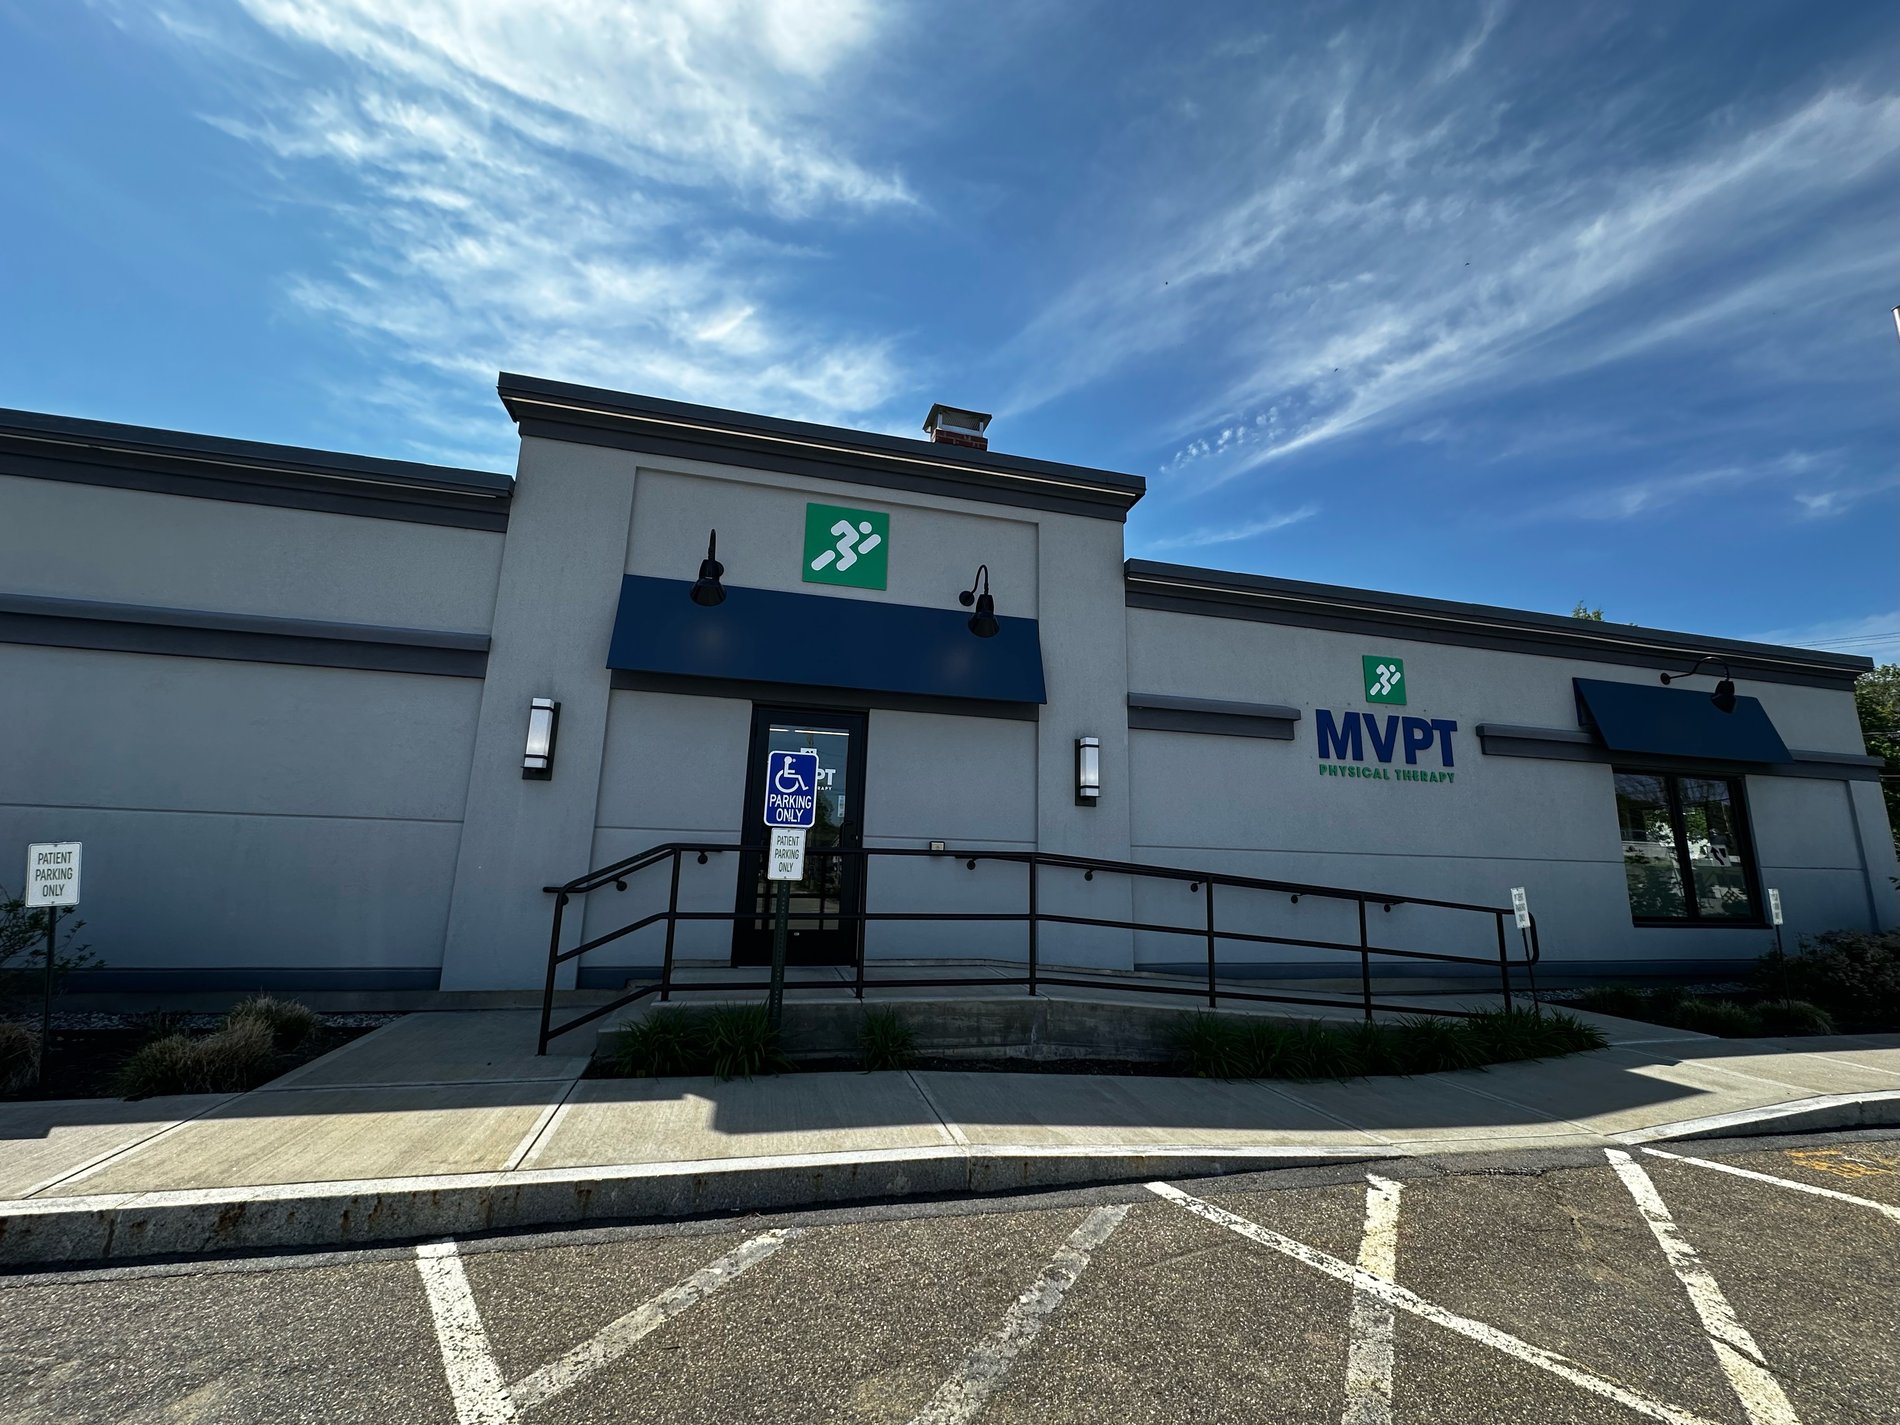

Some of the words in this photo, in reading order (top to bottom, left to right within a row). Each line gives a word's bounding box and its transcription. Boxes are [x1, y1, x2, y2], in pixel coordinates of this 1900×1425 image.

[1315, 708, 1458, 767] MVPT
[817, 768, 836, 786] PT
[1319, 763, 1390, 781] PHYSICAL
[1394, 768, 1456, 784] THERAPY
[769, 794, 812, 809] PARKING
[775, 809, 804, 823] ONLY
[776, 835, 800, 846] PATIENT
[37, 851, 73, 865] PATIENT
[774, 848, 800, 860] PARKING
[35, 867, 73, 881] PARKING
[778, 861, 794, 873] ONLY
[42, 883, 65, 897] ONLY
